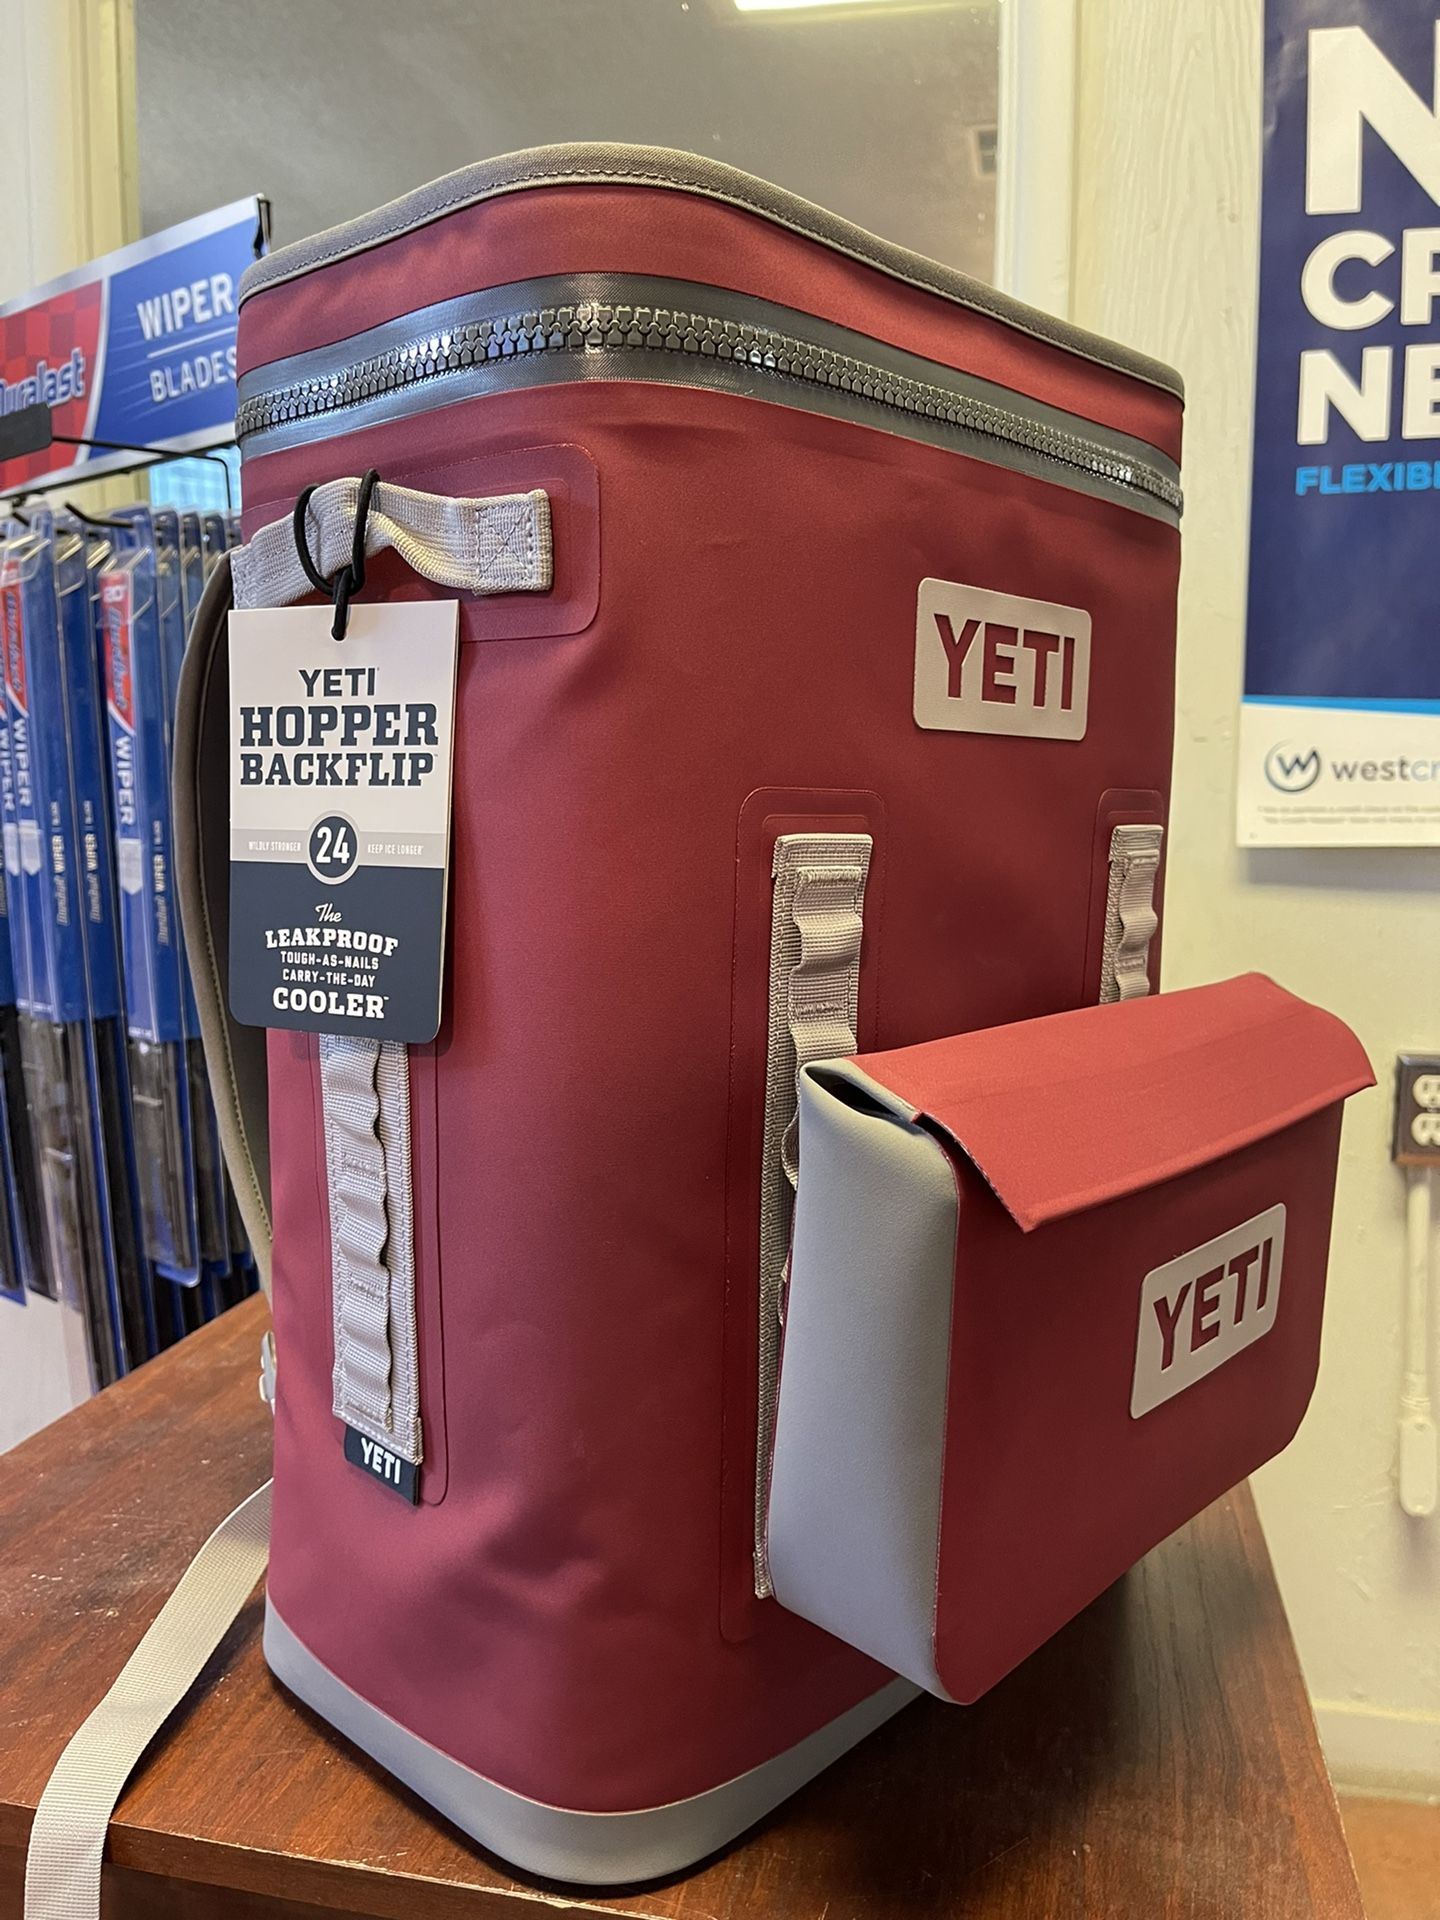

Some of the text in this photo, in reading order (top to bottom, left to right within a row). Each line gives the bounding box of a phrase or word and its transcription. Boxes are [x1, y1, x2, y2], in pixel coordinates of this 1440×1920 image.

[137, 272, 234, 340] WIPER
[150, 345, 237, 402] BLADES
[934, 613, 1076, 712] YETI
[298, 667, 376, 698] YETI
[239, 703, 439, 747] HOPPER
[14, 718, 31, 806] WIPER
[239, 752, 434, 787] BACKFLIP
[116, 736, 135, 825] WIPER
[248, 841, 301, 852] WILDLY STRONGER
[316, 826, 350, 864] 24
[367, 843, 383, 854] KEEP
[384, 845, 396, 854] ICE
[315, 902, 342, 923] The
[265, 927, 399, 956] LEAKPROOF
[280, 951, 379, 970] TOUGH-AS-NAILS
[282, 969, 376, 988] CARRY-THE-DAY
[272, 986, 385, 1019] COOLER
[1153, 1237, 1273, 1373] YETI
[361, 1437, 401, 1484] YETI
